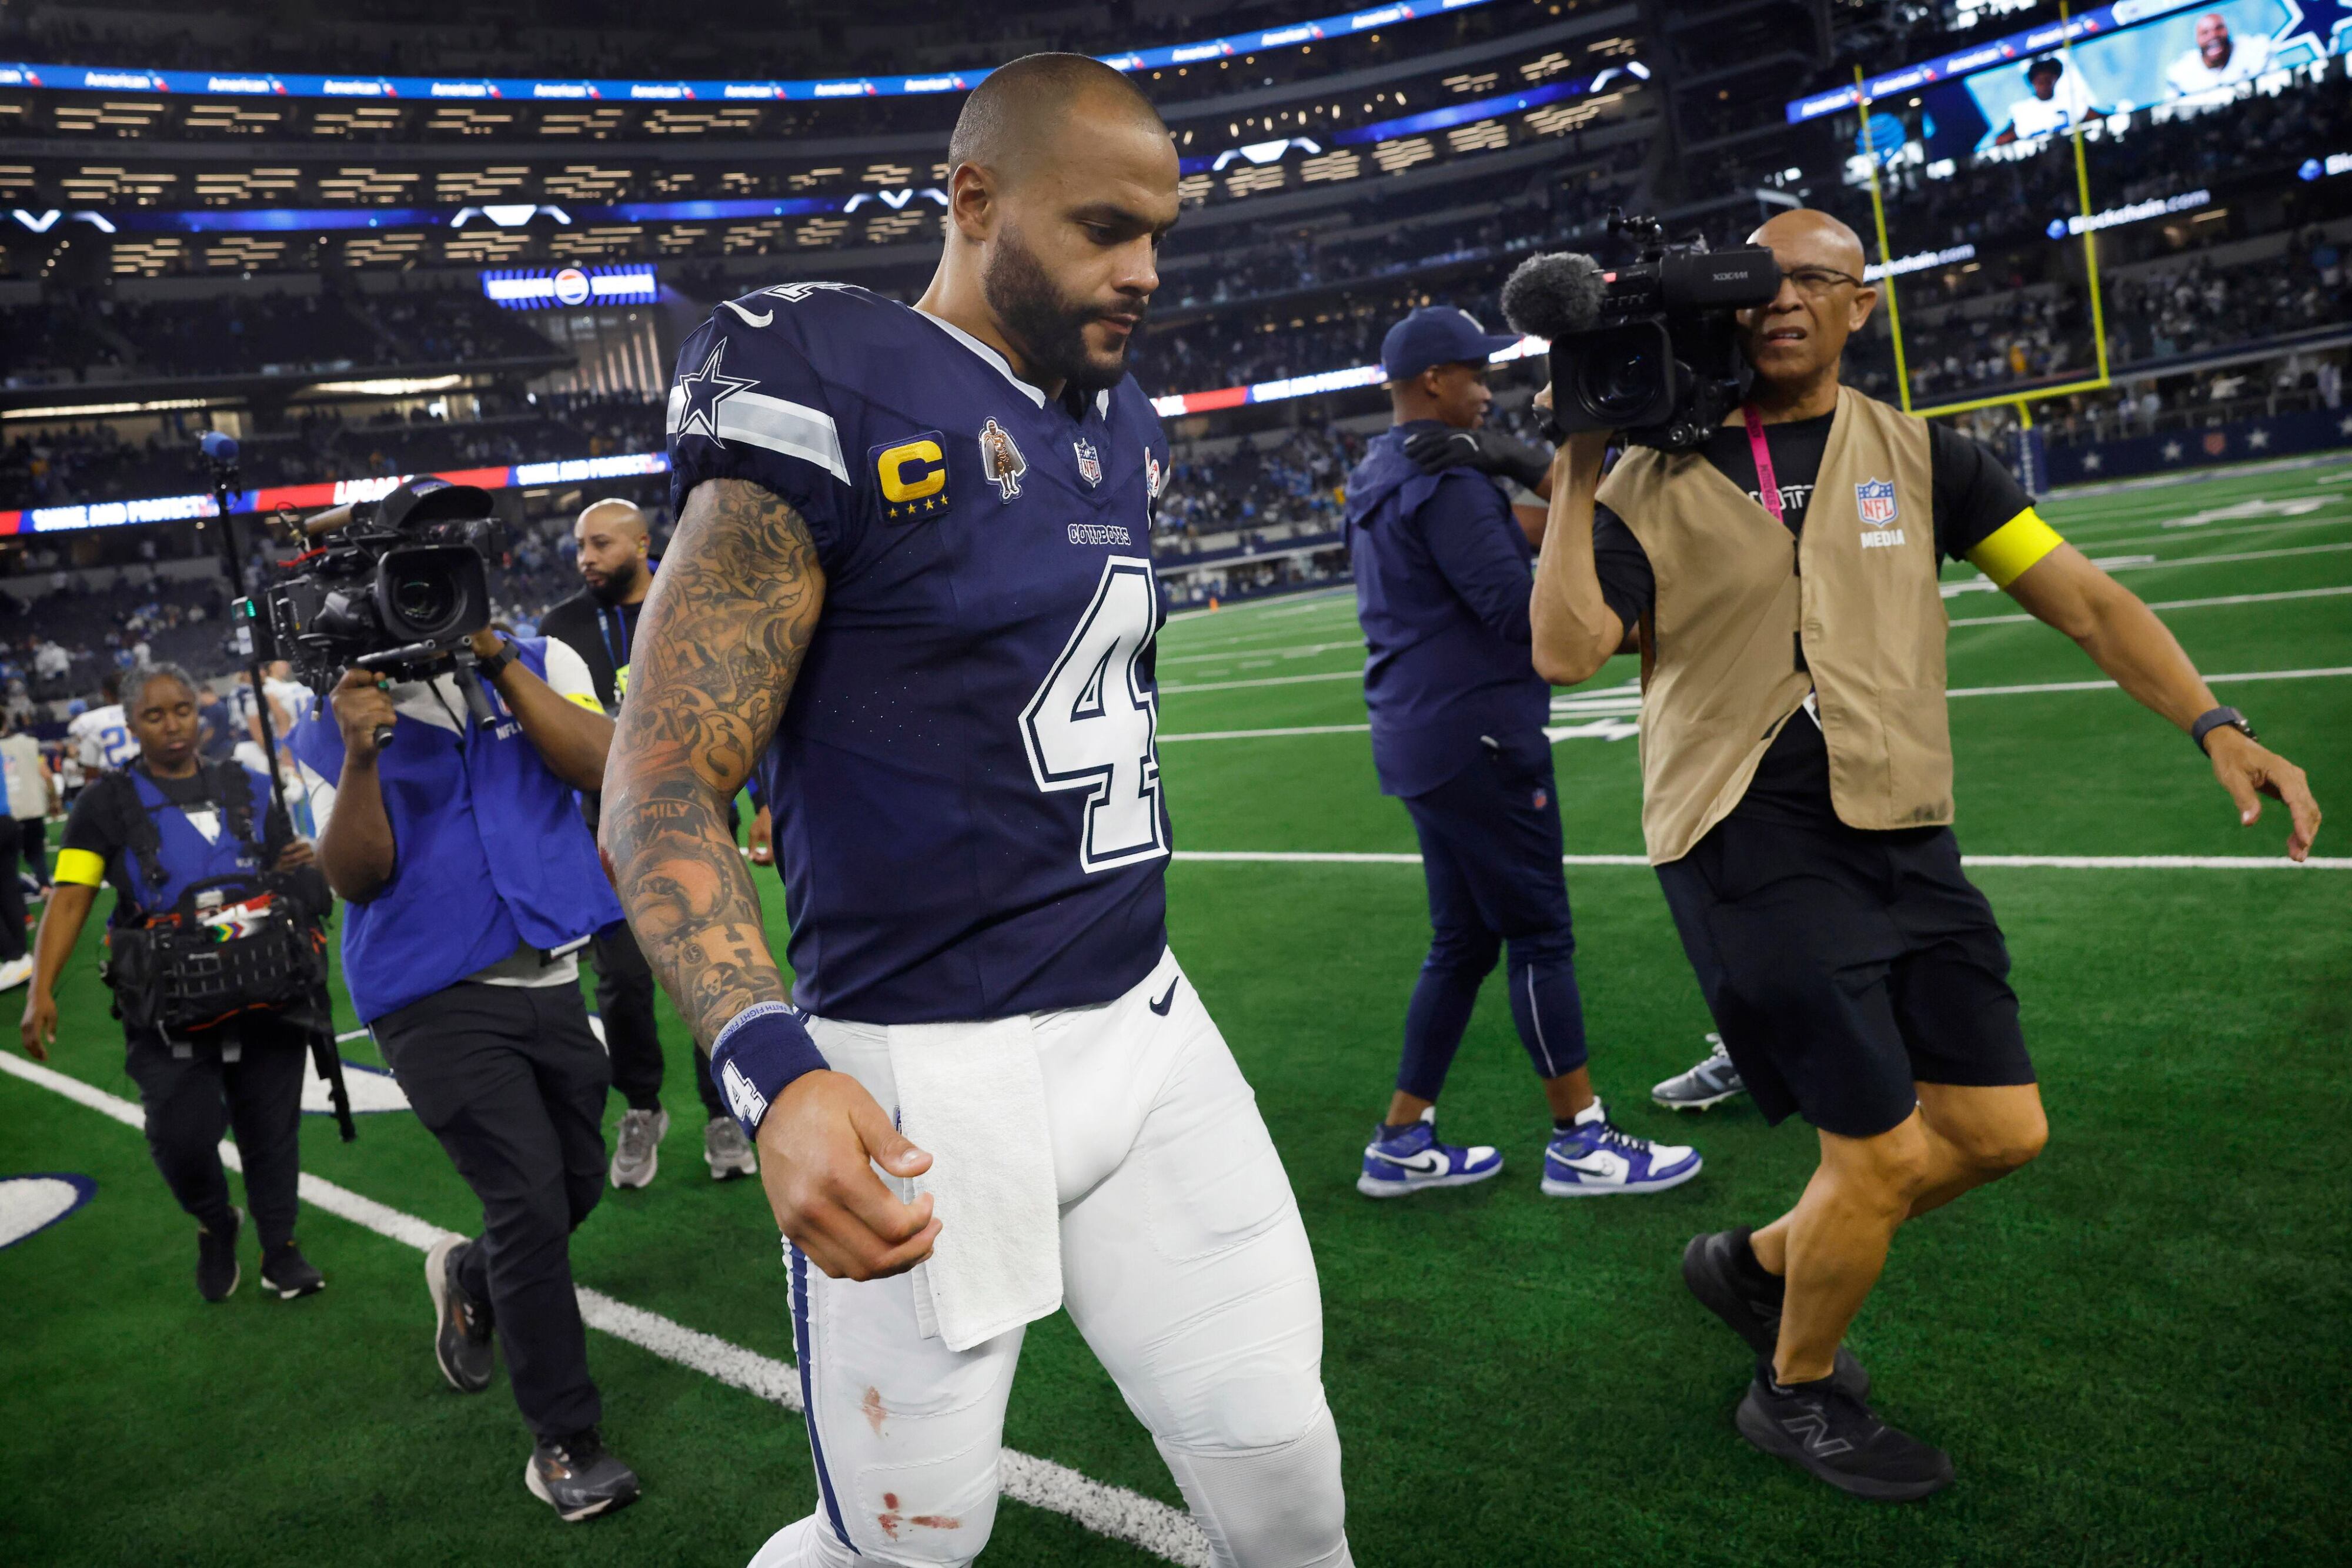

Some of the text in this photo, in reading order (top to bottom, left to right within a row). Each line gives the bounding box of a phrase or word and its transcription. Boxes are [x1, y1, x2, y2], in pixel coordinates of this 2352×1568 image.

[85, 71, 151, 90] American
[208, 77, 270, 93] American
[323, 79, 382, 95] American
[2068, 189, 2210, 235] Blockchain.com
[1863, 243, 1975, 283] lockchain.com
[877, 440, 946, 503] C
[1083, 459, 1100, 479] NFL
[1862, 498, 1893, 520] NFL
[1067, 523, 1131, 546] COWBOYS
[1860, 529, 1906, 549] MEDIA
[1018, 555, 1170, 874] 4
[740, 1006, 764, 1024] FIGHT
[721, 1058, 769, 1127] 4
